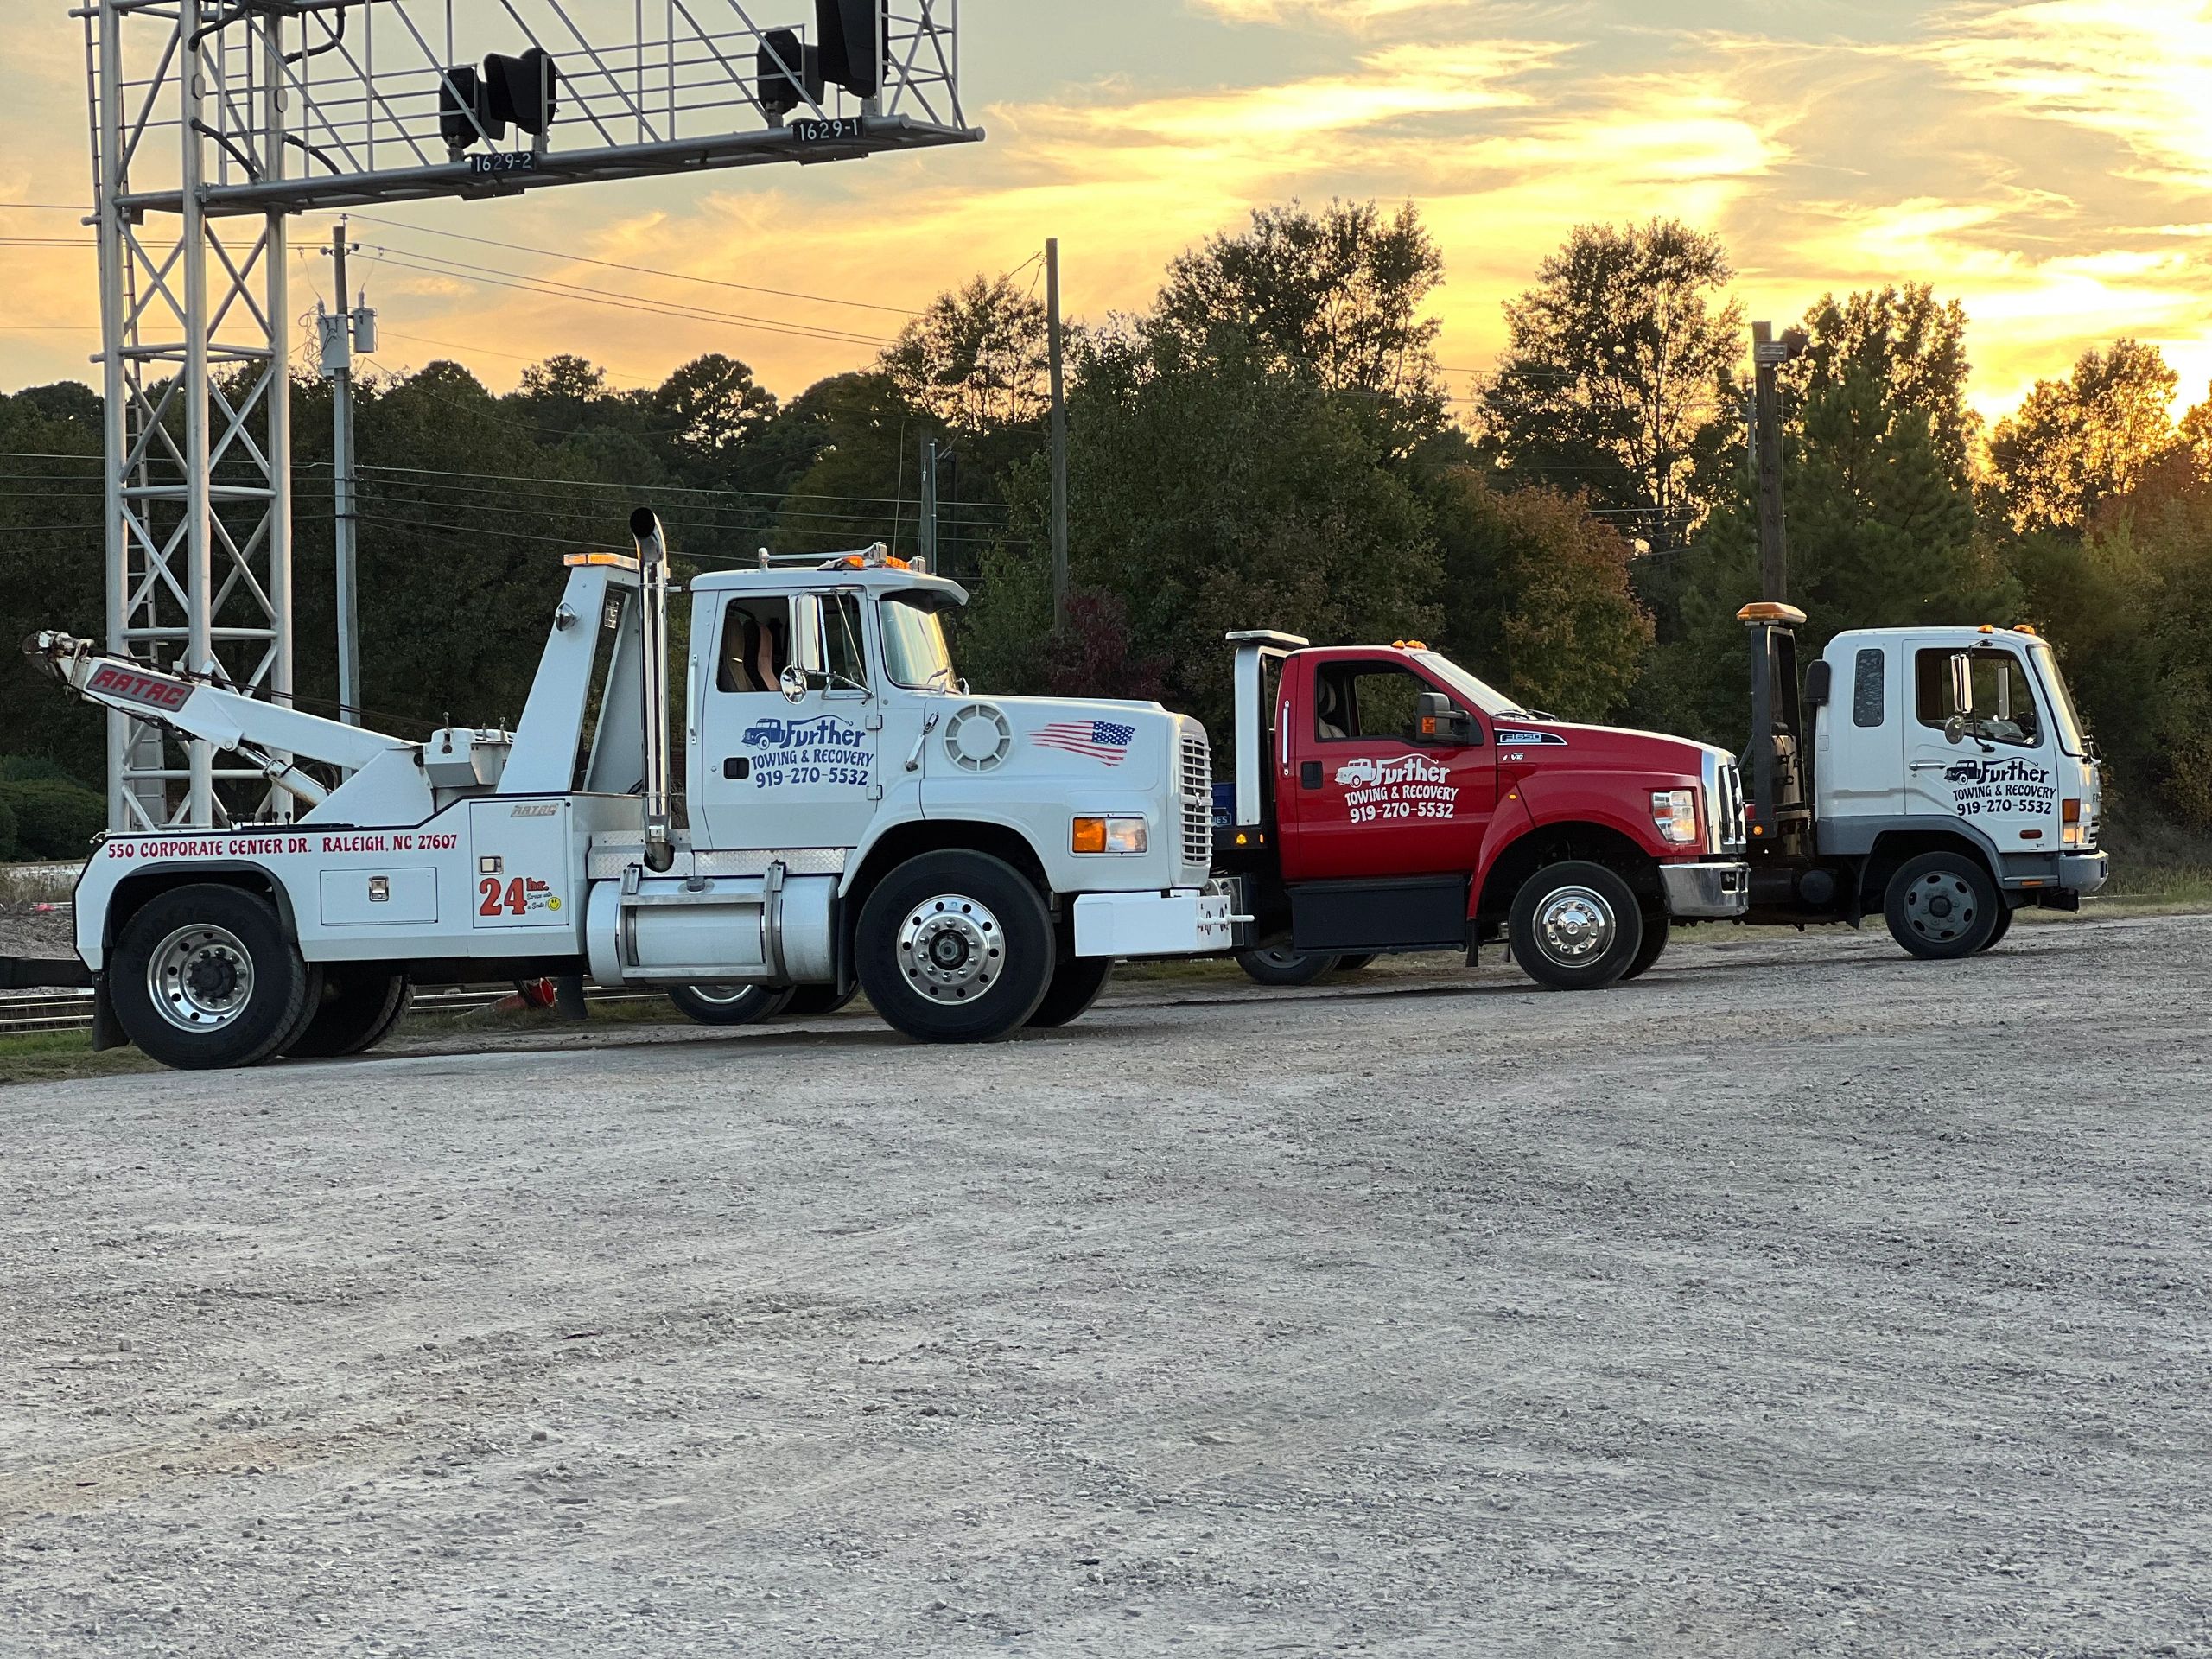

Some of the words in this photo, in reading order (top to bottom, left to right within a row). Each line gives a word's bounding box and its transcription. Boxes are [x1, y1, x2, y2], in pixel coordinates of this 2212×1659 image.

[799, 118, 858, 141] 1629-1
[475, 152, 532, 172] 1629-2
[779, 715, 867, 749] Further
[751, 749, 798, 770] TOWING
[801, 749, 810, 763] &
[813, 748, 874, 767] RECOVERY
[1370, 753, 1451, 787] Further
[755, 767, 868, 789] 919-270-5532
[1976, 757, 2050, 785] Further
[1344, 786, 1388, 807] TOWING
[1391, 785, 1400, 799] &
[1402, 785, 1459, 802] RECOVERY
[1953, 785, 1992, 802] TOWING
[1994, 785, 2002, 796] &
[2005, 784, 2056, 799] RECOVERY
[1350, 802, 1455, 823] 919-270-5532
[1956, 799, 2053, 817] 919-270-5532
[108, 843, 135, 859] 550
[140, 840, 224, 858] CORPORATE
[229, 838, 283, 855] CENTER
[288, 837, 312, 854] DR.
[322, 836, 389, 853] RALEIGH,
[393, 835, 412, 851] NC
[417, 834, 457, 849] 27607
[479, 877, 528, 916] 24
